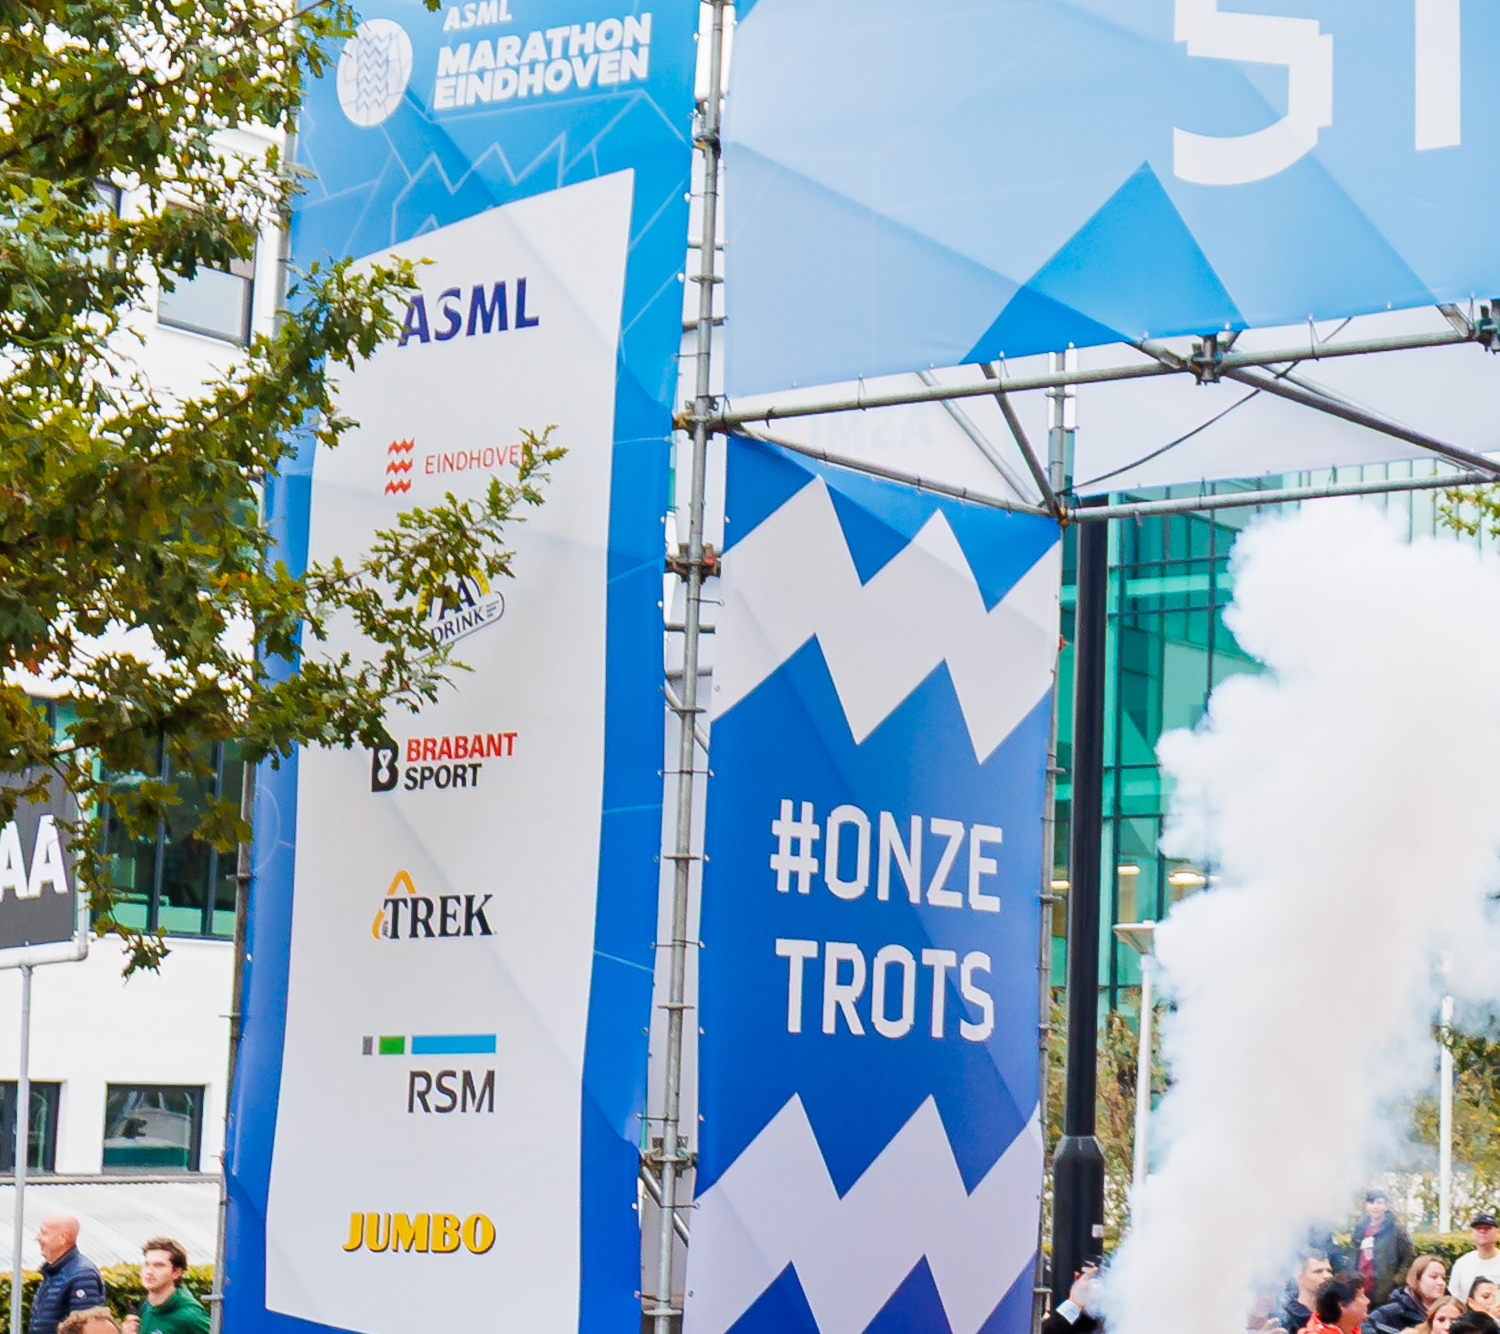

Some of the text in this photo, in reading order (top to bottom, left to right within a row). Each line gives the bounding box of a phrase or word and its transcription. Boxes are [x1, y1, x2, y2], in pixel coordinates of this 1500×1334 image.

[435, 13, 652, 79] MARATHON
[434, 46, 651, 111] EINDHOVEN
[398, 277, 540, 348] ASML
[430, 604, 486, 645] DRINK
[406, 732, 518, 763] BRABANT
[404, 763, 482, 791] SPORT
[769, 799, 1004, 913] #ONZE
[383, 893, 494, 940] TREK
[775, 938, 996, 1043] TROTS
[406, 1070, 496, 1114] RSM
[342, 1212, 497, 1255] JUMBO
